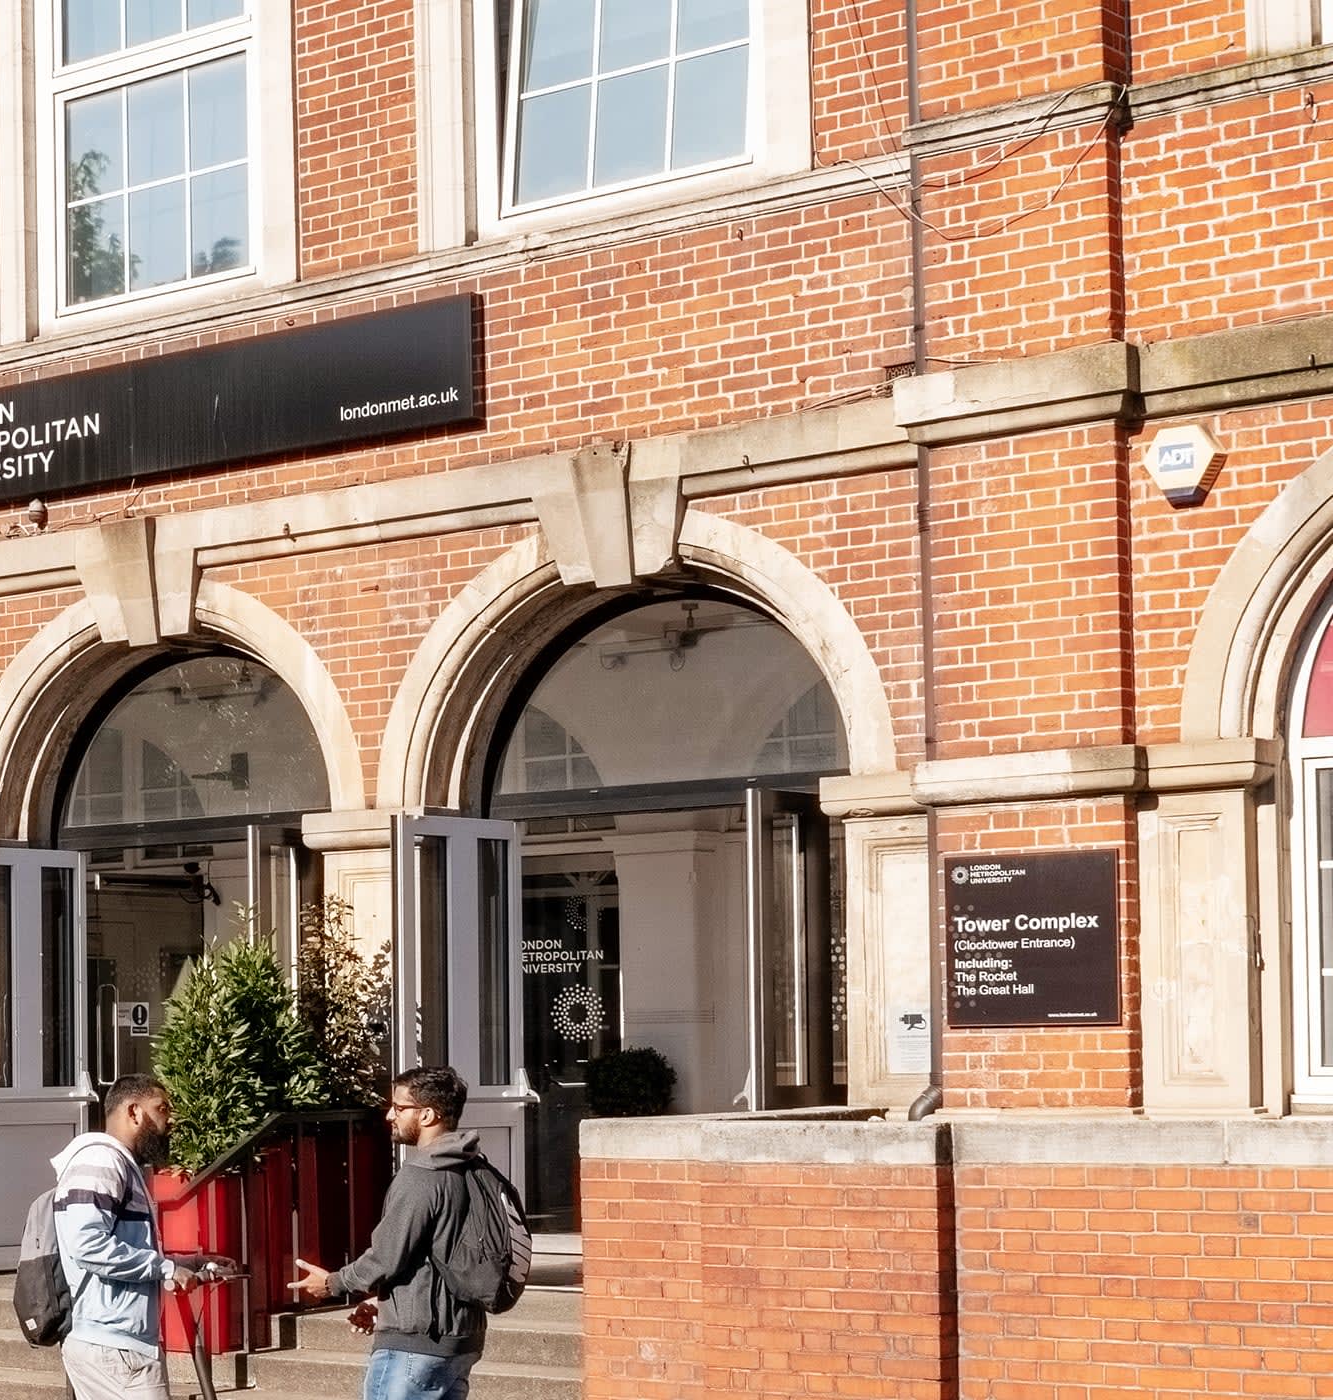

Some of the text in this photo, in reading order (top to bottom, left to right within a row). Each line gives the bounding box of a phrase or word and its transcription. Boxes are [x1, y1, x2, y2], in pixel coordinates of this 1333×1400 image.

[340, 386, 459, 421] londonmet.ac.uk
[1160, 447, 1195, 466] ADT
[970, 869, 1026, 878] METROPOLITAN
[970, 876, 1013, 885] UNIVERSITY
[954, 912, 1099, 933] Tower Complex
[520, 939, 562, 950] ONDON
[954, 936, 1076, 952] (Clocktower Entrance)
[521, 950, 604, 962] ETROPOLITAN
[522, 962, 582, 974] NIVERSITY
[954, 958, 1013, 970] Including:
[955, 971, 1018, 982] The Rocket
[955, 984, 1035, 996] The Great Hall
